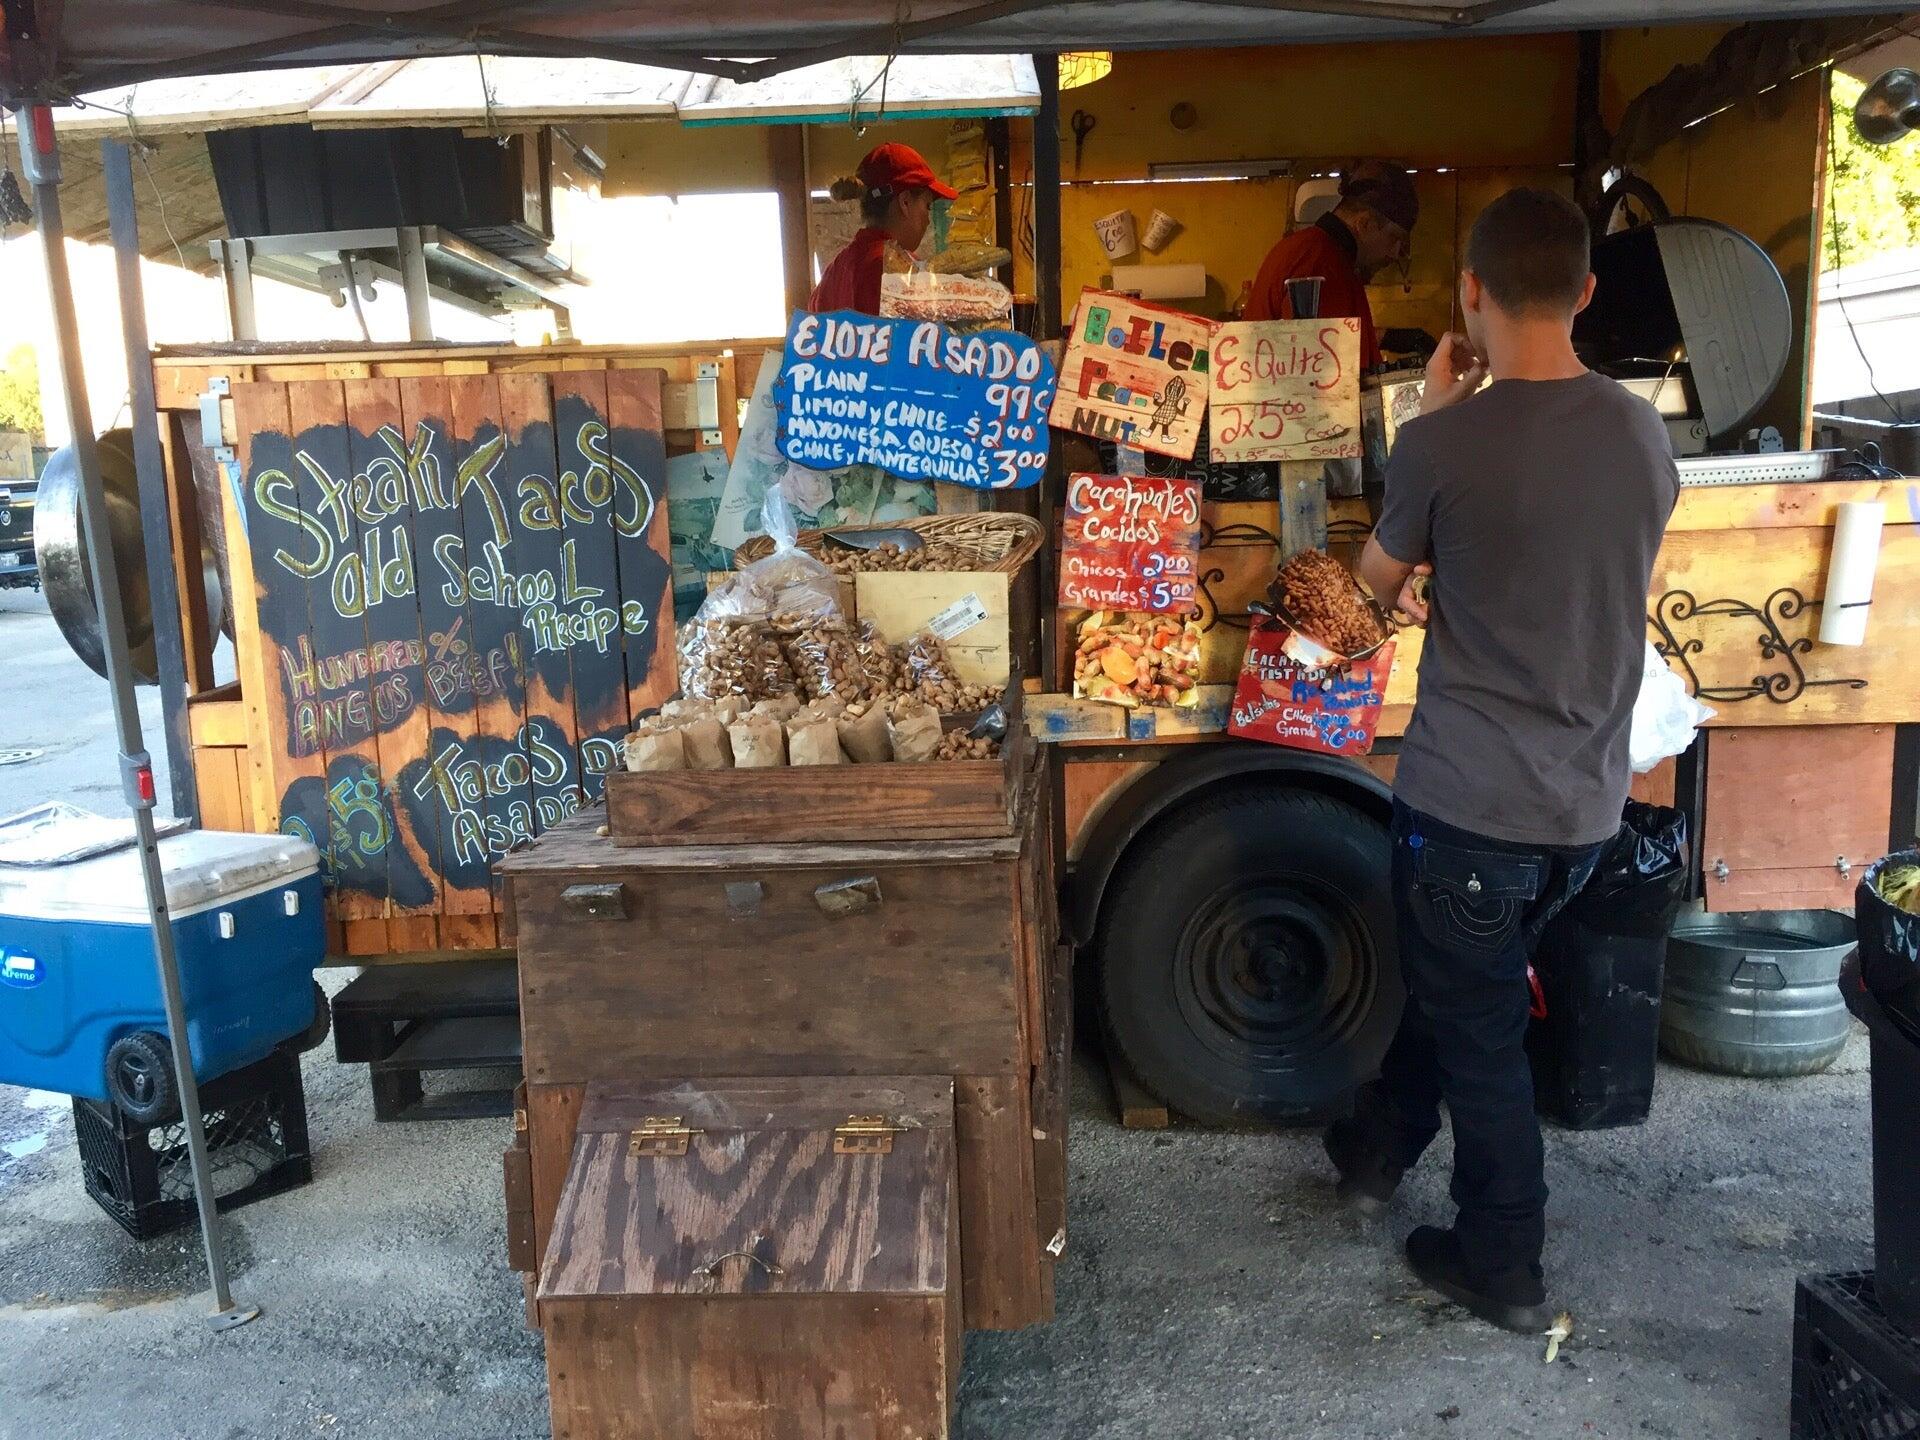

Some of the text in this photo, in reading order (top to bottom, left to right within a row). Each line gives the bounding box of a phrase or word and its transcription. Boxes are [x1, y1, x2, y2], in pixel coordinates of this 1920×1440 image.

[793, 315, 1041, 382] ELOTE ASADO
[786, 363, 868, 393] PLAIN
[885, 401, 948, 432] CHILE
[908, 430, 973, 461] QUESO
[787, 439, 845, 461] CHILE
[858, 446, 982, 485] MANTEQUILLA
[1083, 516, 1160, 545] Cocidos
[1068, 557, 1127, 578] Chicos
[1064, 580, 1138, 606] Grandes
[523, 600, 650, 654] Recipe
